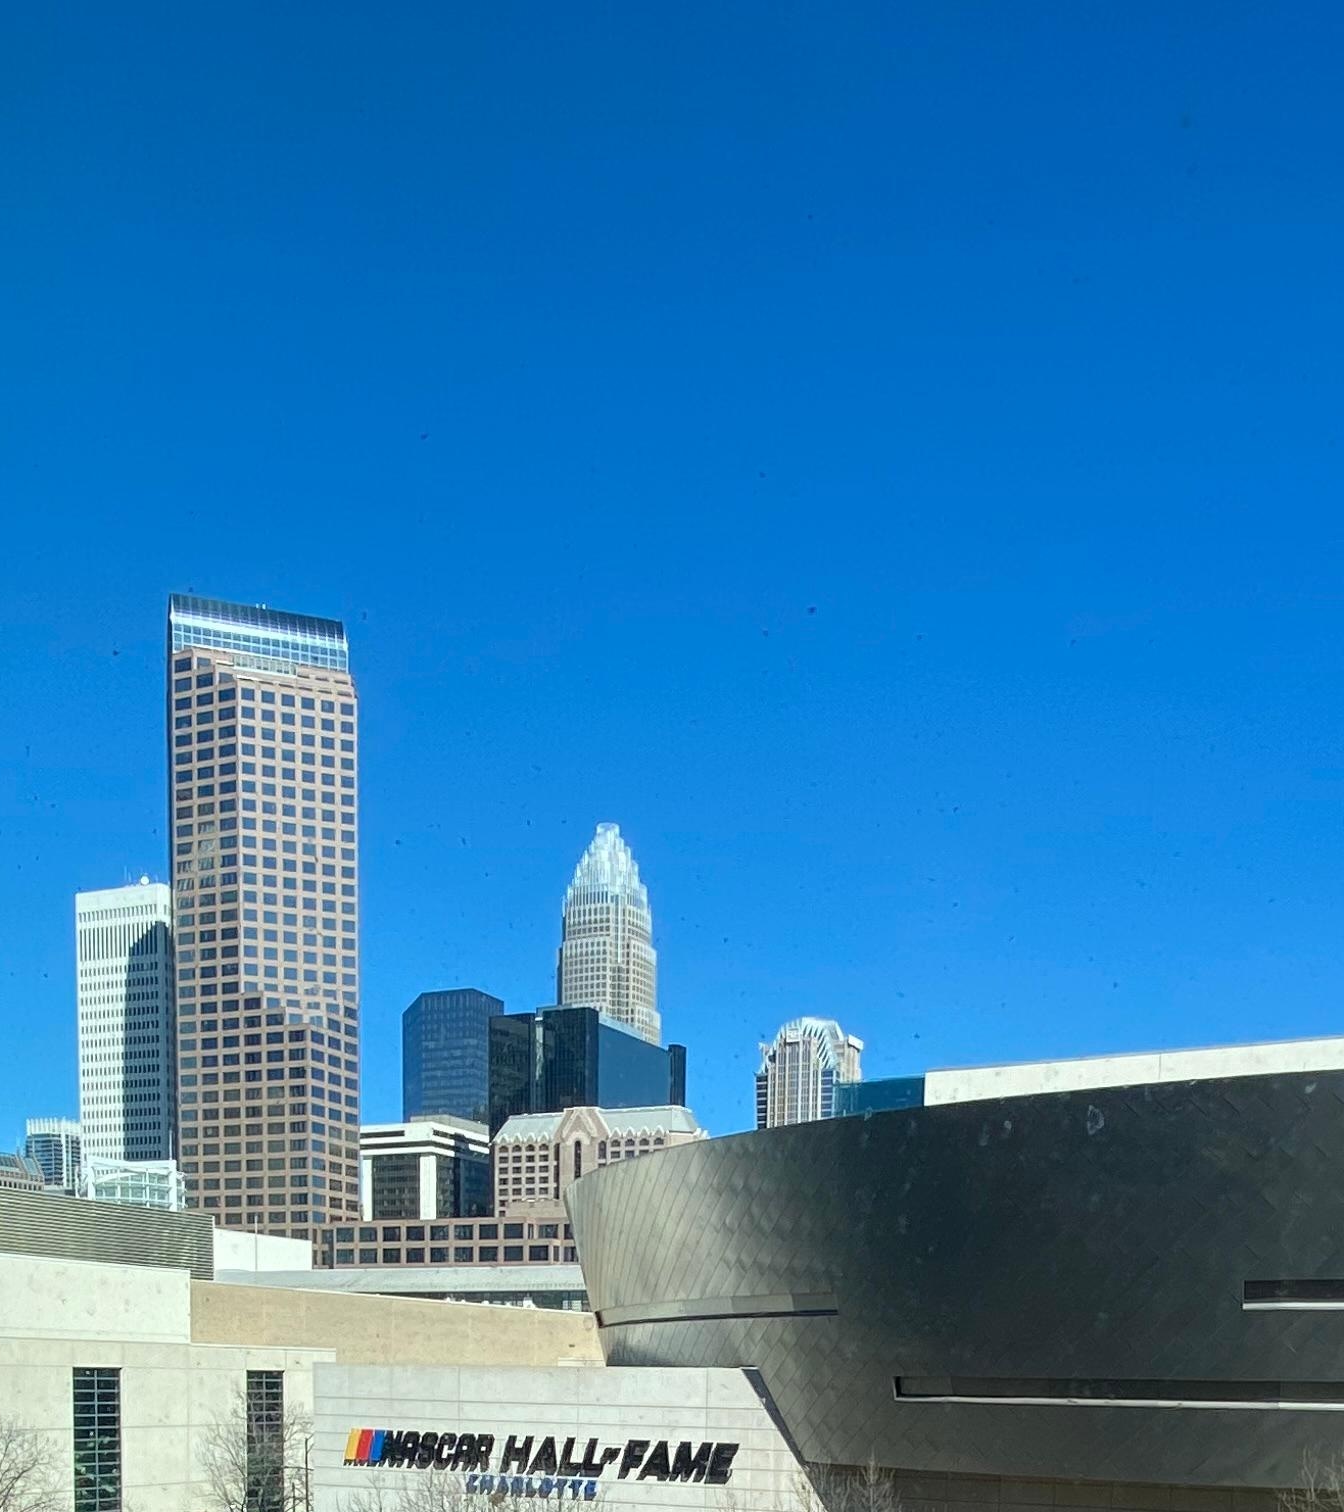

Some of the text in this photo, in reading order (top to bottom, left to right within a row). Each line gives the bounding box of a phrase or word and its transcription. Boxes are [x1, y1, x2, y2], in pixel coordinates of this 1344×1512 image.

[378, 1430, 495, 1474] NASCAR
[500, 1434, 604, 1477] HALL
[617, 1439, 740, 1485] FAME
[466, 1473, 598, 1501] CHARLOTTE
